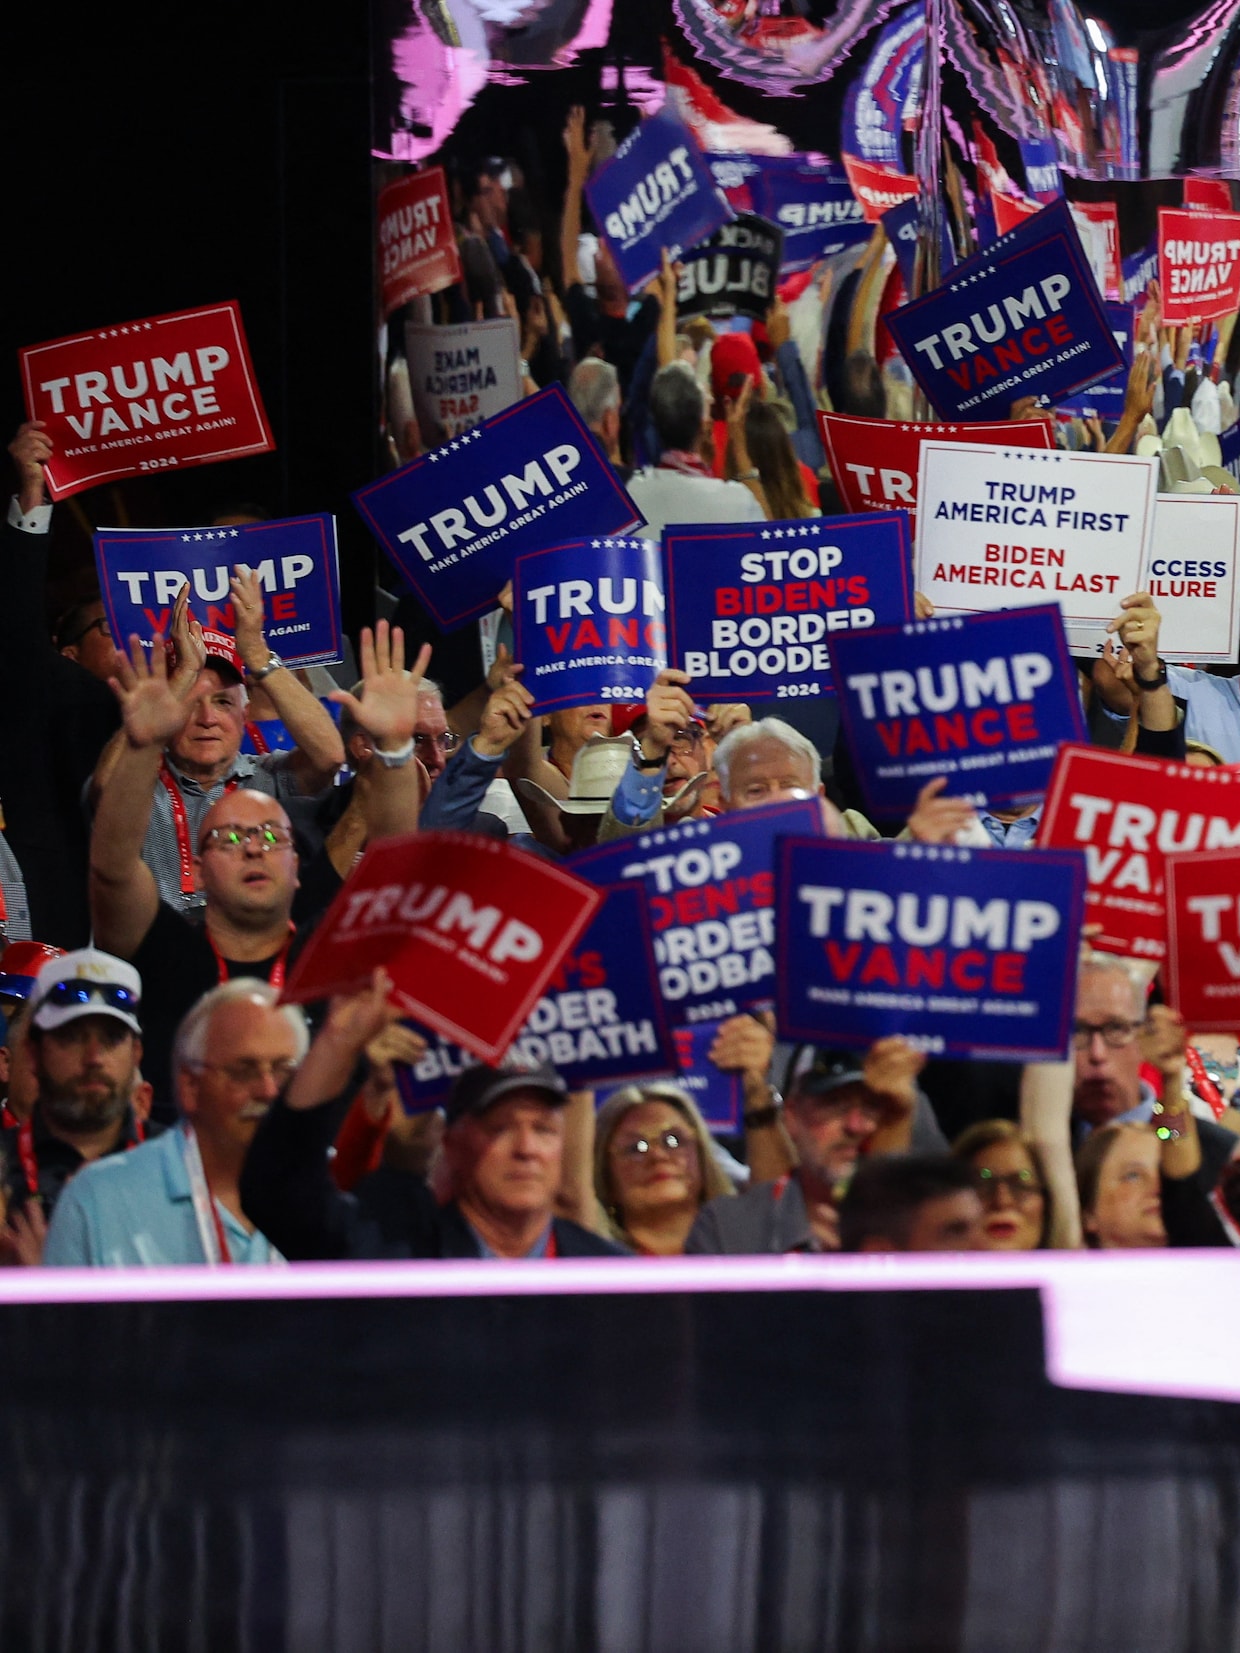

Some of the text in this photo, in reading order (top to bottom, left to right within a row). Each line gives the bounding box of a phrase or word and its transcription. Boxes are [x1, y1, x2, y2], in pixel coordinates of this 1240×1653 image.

[914, 273, 1071, 371] TRUMP
[946, 314, 1074, 391] VANCE
[40, 345, 230, 414] TRUMP
[957, 341, 1091, 412] MAKE AMERICA GREAT AGAIN!
[66, 386, 221, 440] VANCE
[65, 416, 237, 457] MAKE AMERICA GREAT AGAIN!
[139, 455, 179, 471] 2024
[397, 444, 582, 561] TRUMP
[985, 481, 1076, 506] TRUMP
[428, 481, 589, 573] MAKE AMERICA GREAT AGAIN!
[934, 500, 1130, 533] AMERICA FIRST
[740, 545, 843, 583] STOP
[984, 543, 1066, 568] BIDEN
[715, 575, 870, 616] BIDEN'S
[932, 563, 1120, 595] AMERICA LAST
[1149, 580, 1217, 598] ILURE
[527, 577, 666, 624] TRUM
[268, 623, 311, 637] AGAIN!
[545, 618, 667, 655] VANC
[535, 660, 566, 676] MAKE
[568, 655, 625, 669] AMERICA
[847, 652, 1053, 720] TRUMP
[600, 686, 644, 699] 2024
[776, 682, 821, 697] 2024
[877, 704, 1038, 757] VANCE
[339, 882, 543, 963] TRUMP
[798, 884, 1061, 951] TRUMP
[824, 940, 1028, 993] VANCE
